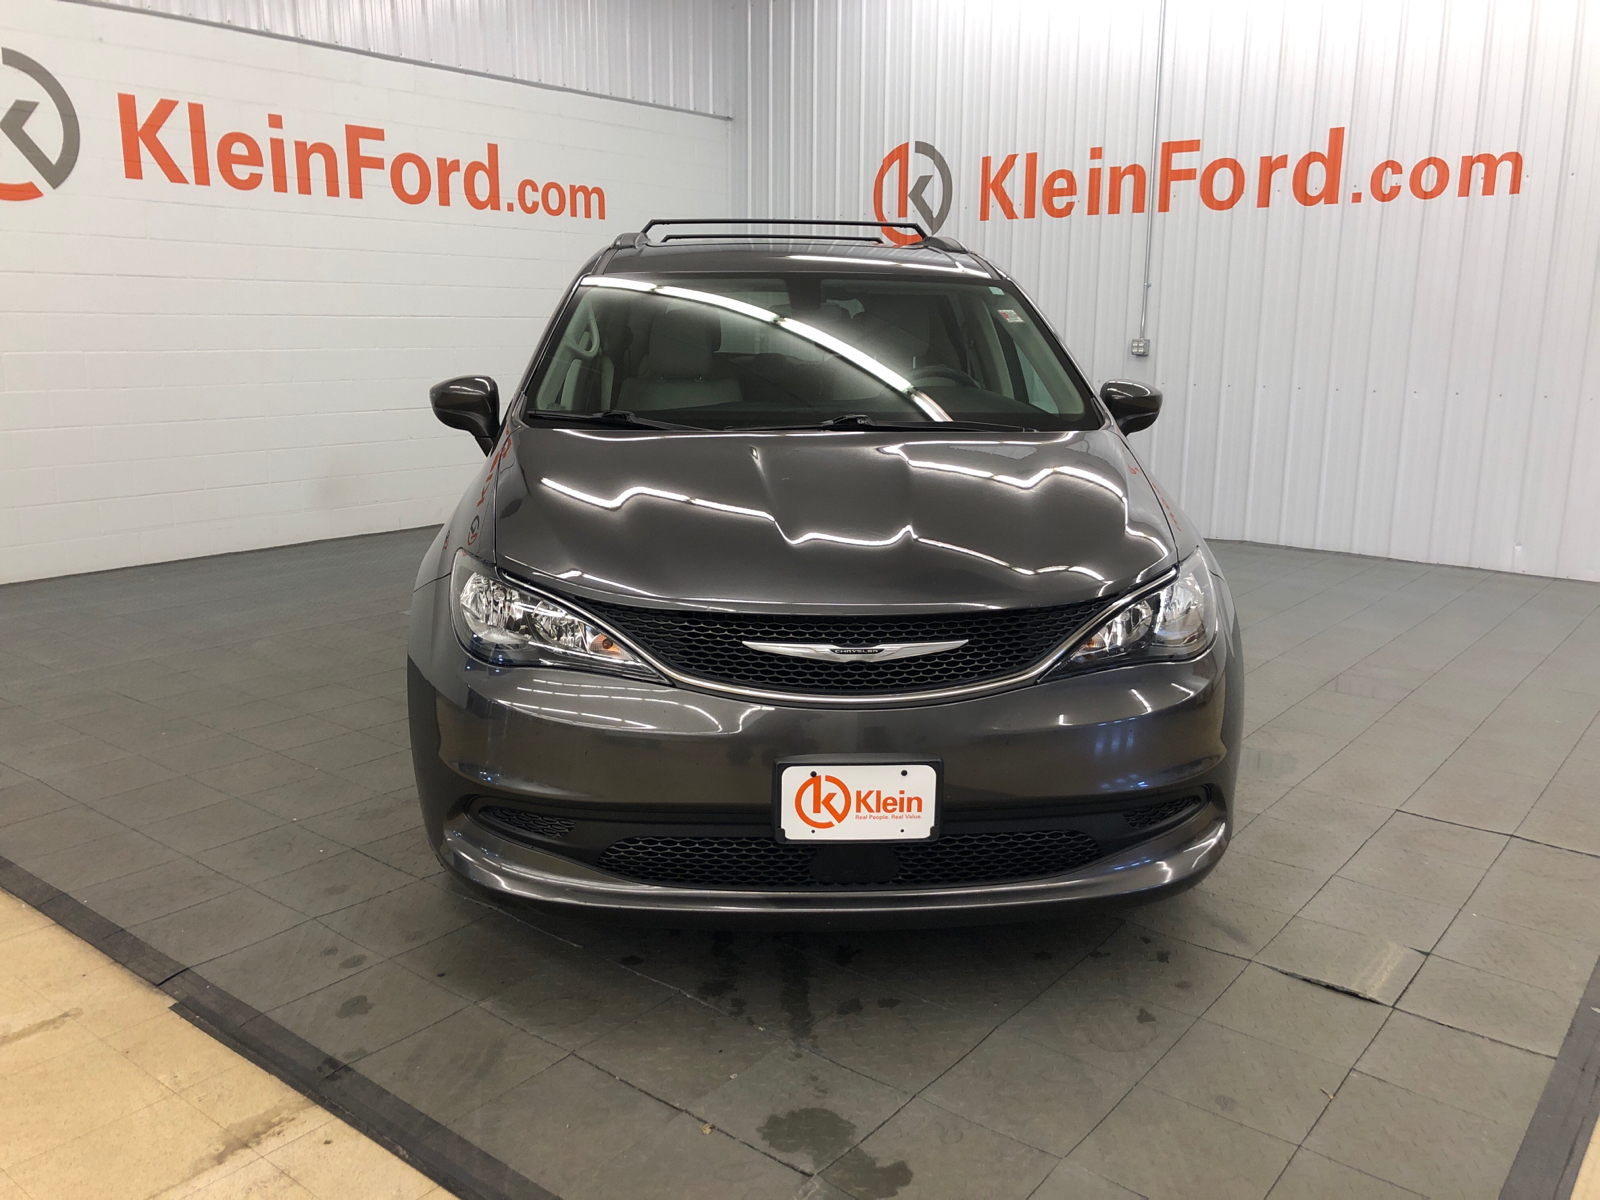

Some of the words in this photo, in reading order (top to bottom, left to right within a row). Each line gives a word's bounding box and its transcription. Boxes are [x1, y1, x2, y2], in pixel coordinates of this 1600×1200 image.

[117, 93, 607, 220] KleinFord.com
[979, 127, 1524, 222] KleinFord.com
[855, 790, 923, 814] Klein
